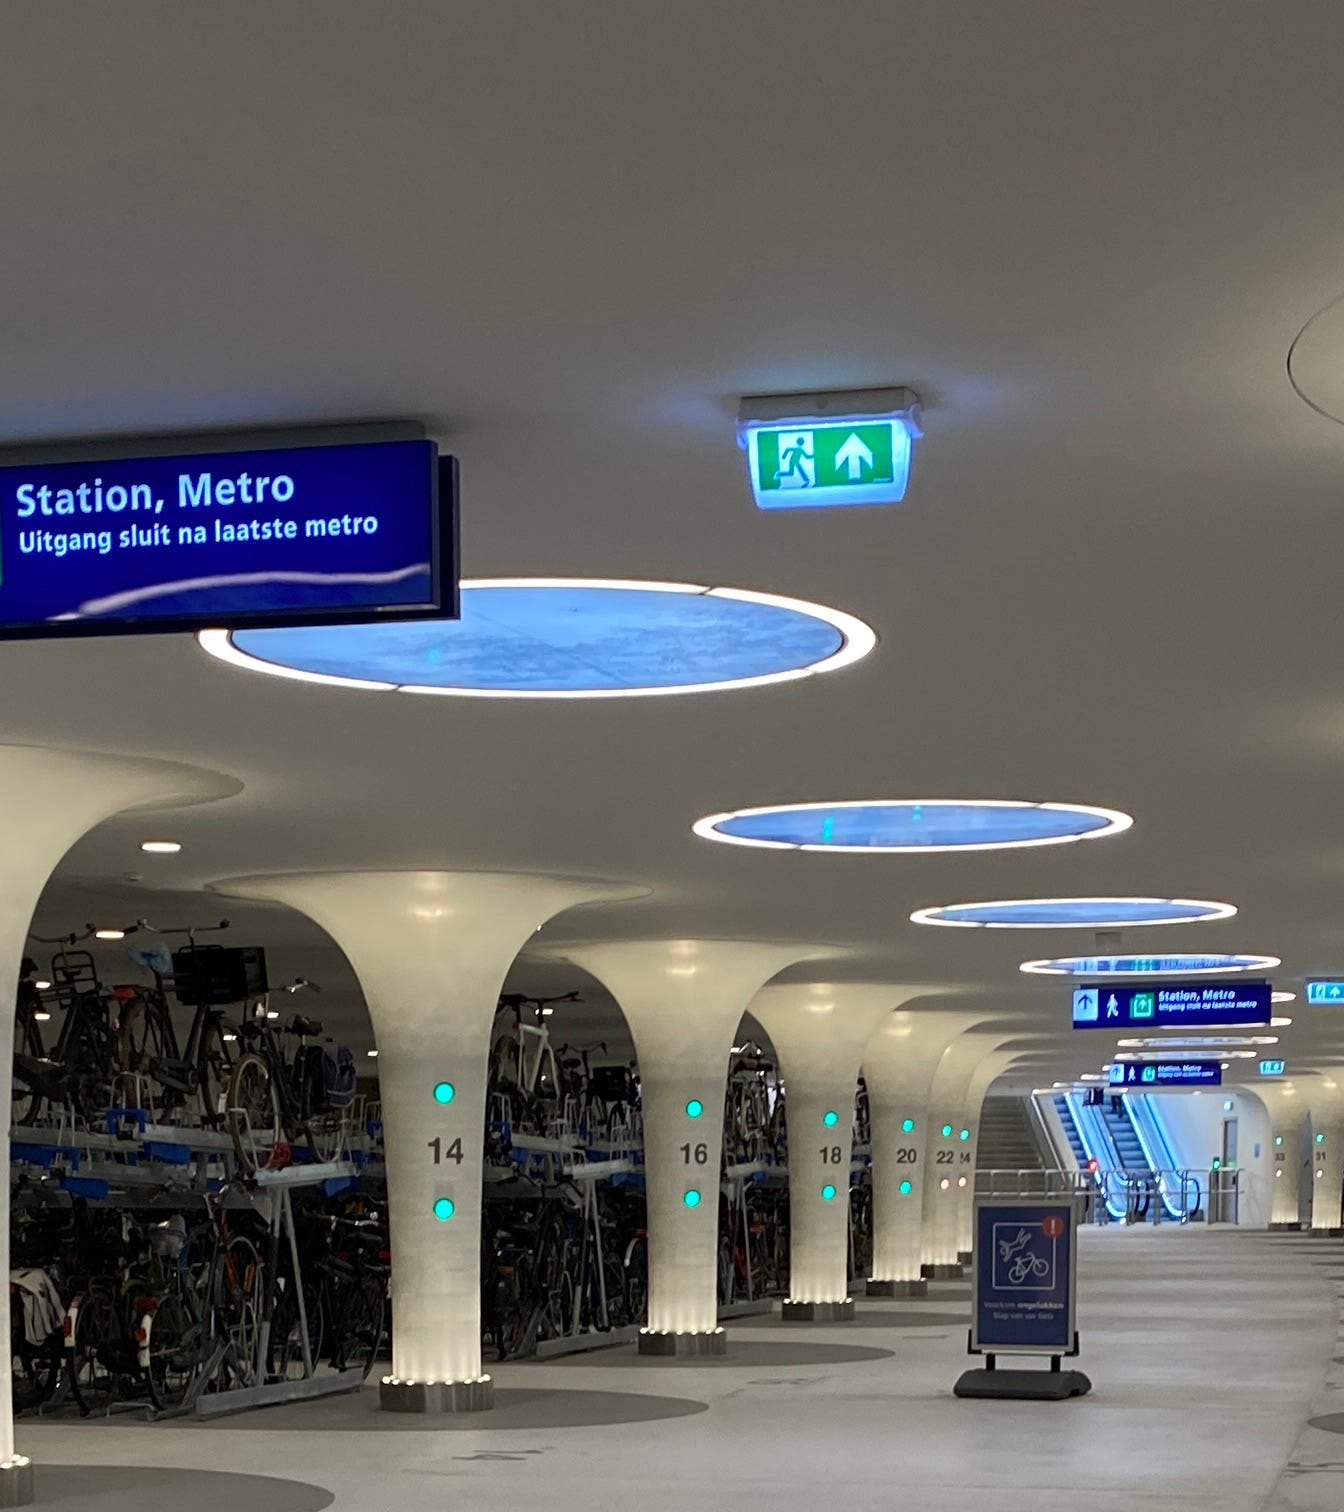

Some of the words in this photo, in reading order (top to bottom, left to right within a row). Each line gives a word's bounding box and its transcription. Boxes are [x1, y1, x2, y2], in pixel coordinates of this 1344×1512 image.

[16, 478, 164, 518] Station,
[178, 472, 295, 508] Metro
[19, 530, 112, 557] Uitgang
[119, 523, 171, 549] sluit
[178, 525, 207, 545] na
[214, 519, 298, 543] laatste
[305, 514, 379, 538] metro
[1202, 989, 1236, 1001] Metro
[427, 1137, 465, 1165] 14
[679, 1143, 708, 1164] 16
[819, 1147, 842, 1164] 18
[896, 1149, 917, 1164] 20
[936, 1150, 954, 1164] 22
